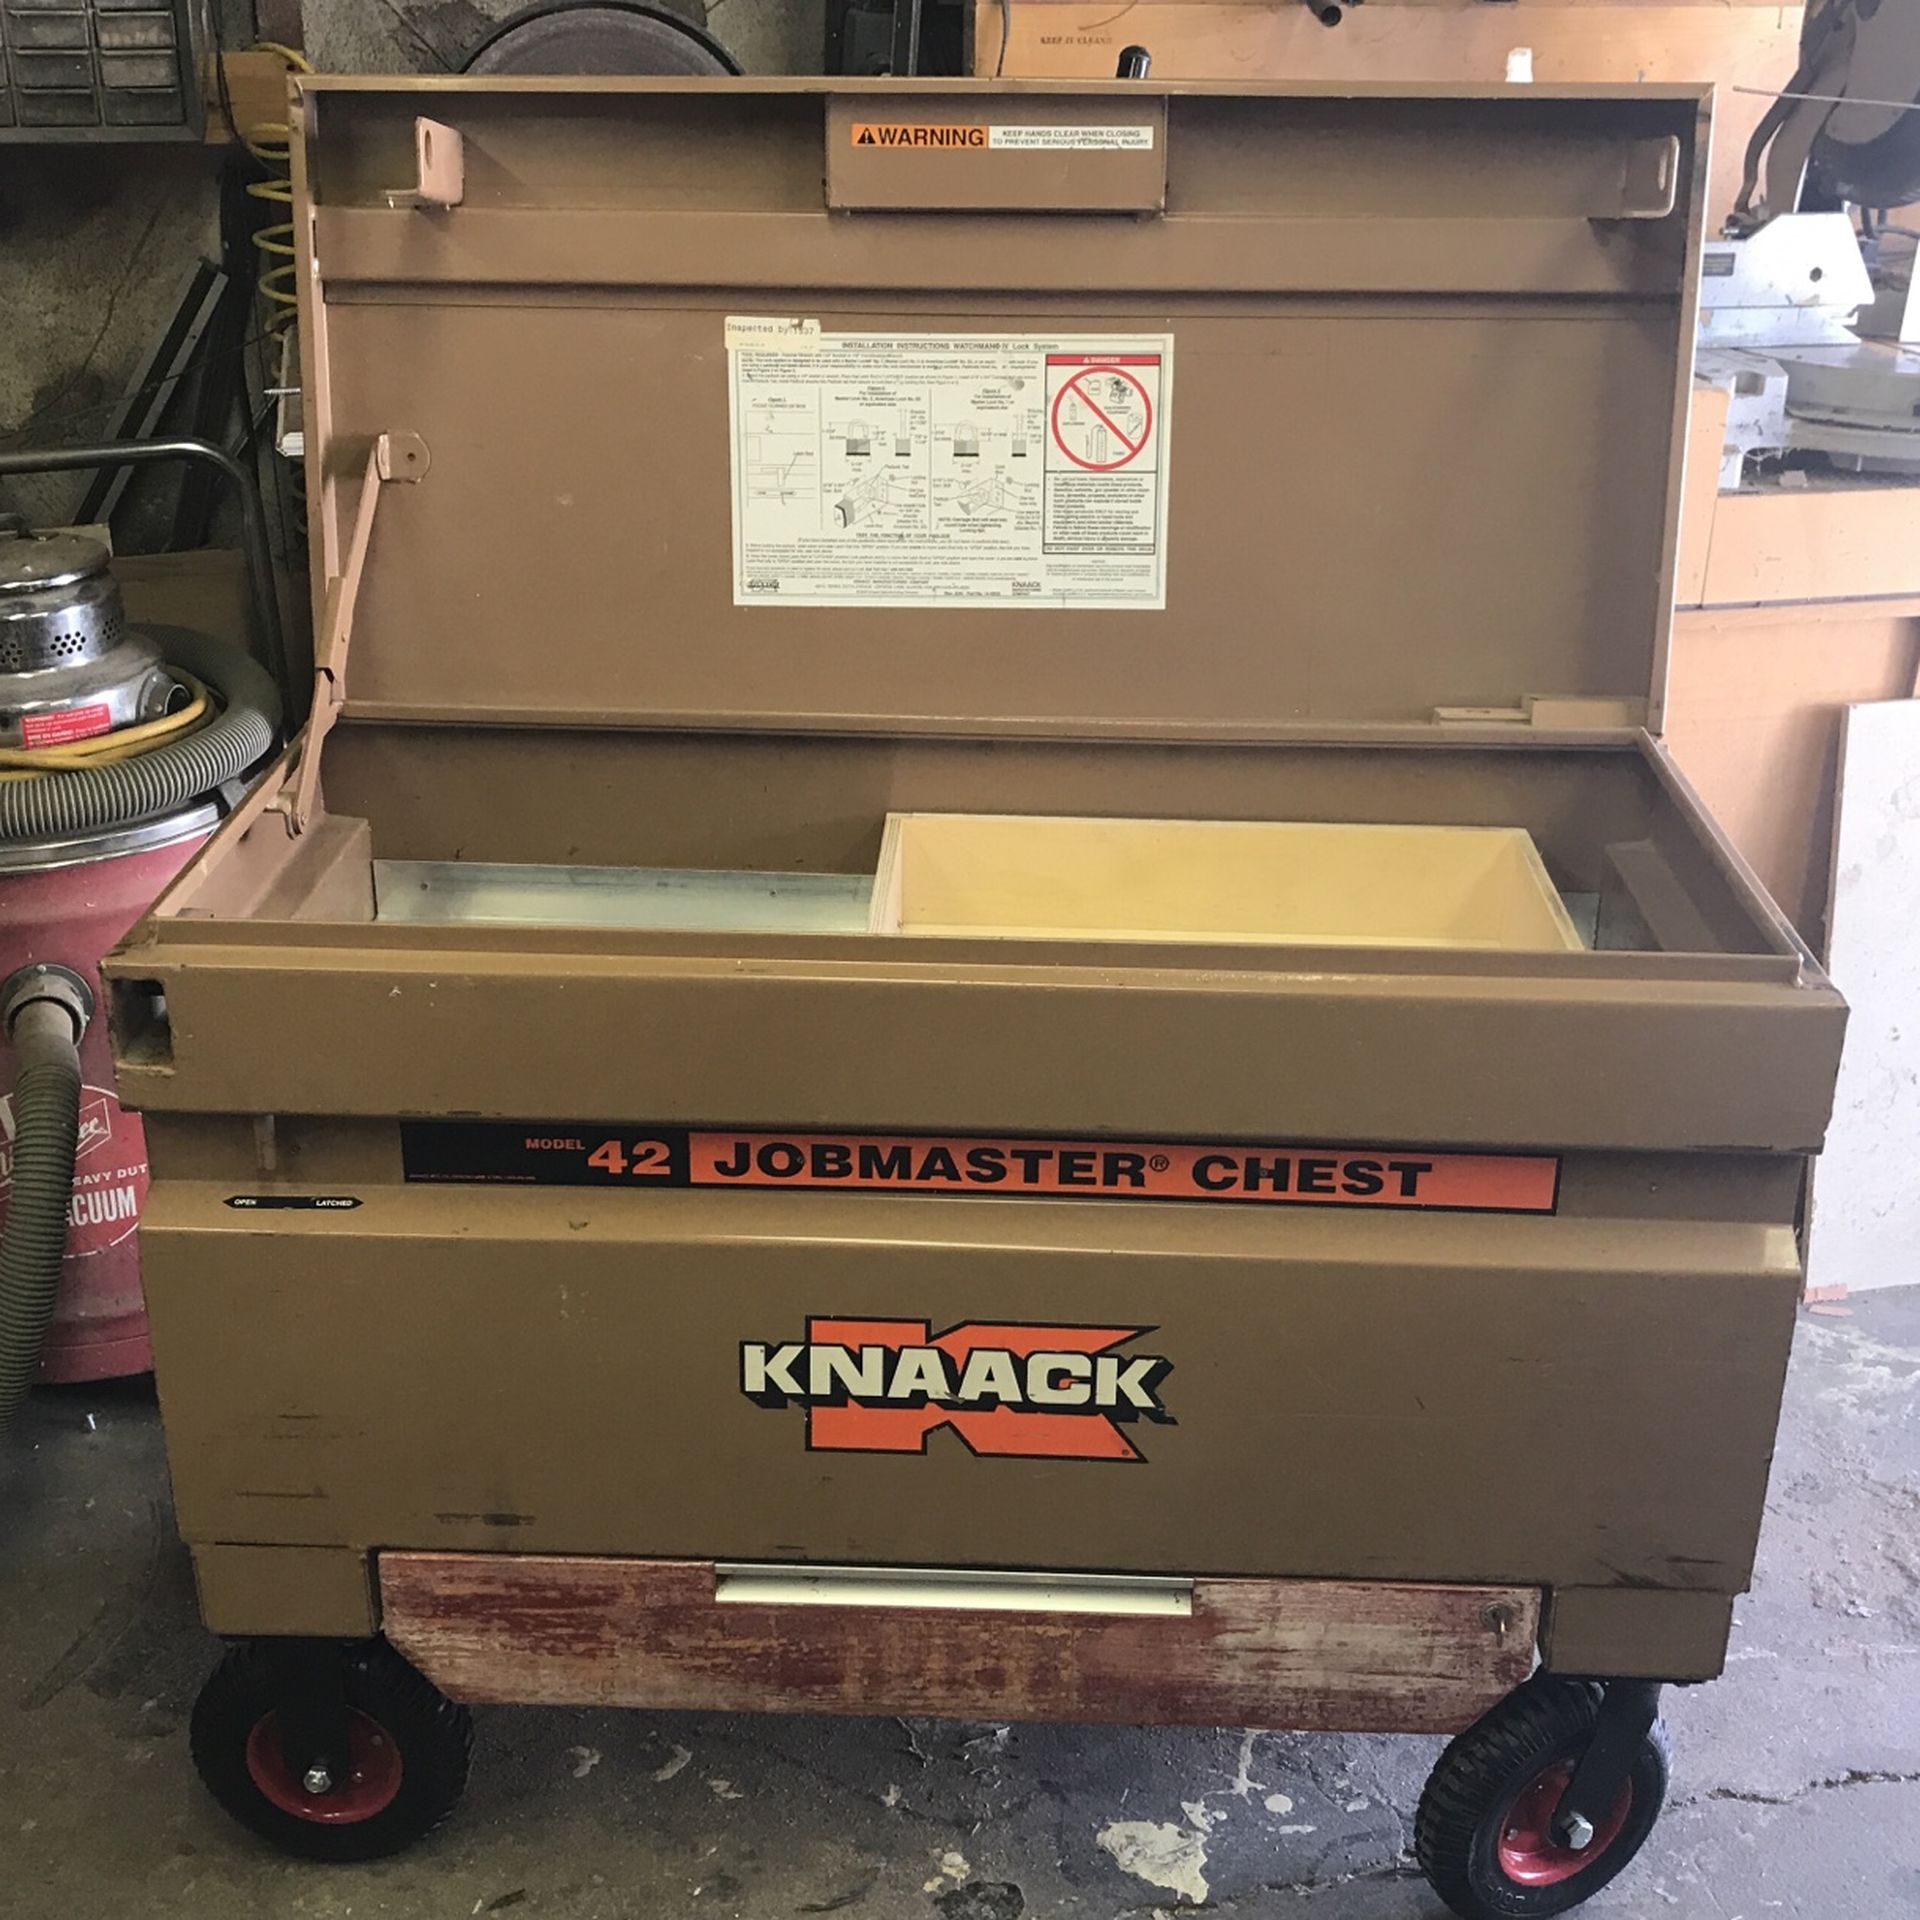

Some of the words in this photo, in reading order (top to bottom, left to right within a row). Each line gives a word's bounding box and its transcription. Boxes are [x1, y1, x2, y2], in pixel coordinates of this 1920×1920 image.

[878, 128, 984, 147] WARNING
[992, 138, 1003, 146] TO
[1005, 138, 1040, 146] PREVENT
[1042, 138, 1077, 146] SERIOUS
[1078, 138, 1119, 146] PERSONAL
[1003, 130, 1023, 138] KEEP
[1025, 130, 1051, 138] HANDS
[1054, 130, 1080, 138] CLEAR
[1081, 130, 1104, 138] WHEN
[1106, 130, 1141, 138] CLOSING
[727, 323, 774, 333] Inspected
[1033, 343, 1059, 351] System
[525, 1138, 585, 1150] MODEL
[588, 1140, 671, 1174] 42
[72, 1171, 112, 1186] EAVY
[117, 1163, 148, 1178] DUT
[1192, 1155, 1432, 1197] CHEST
[65, 1185, 137, 1227] CUUM
[742, 1343, 1165, 1412] KNAACK
